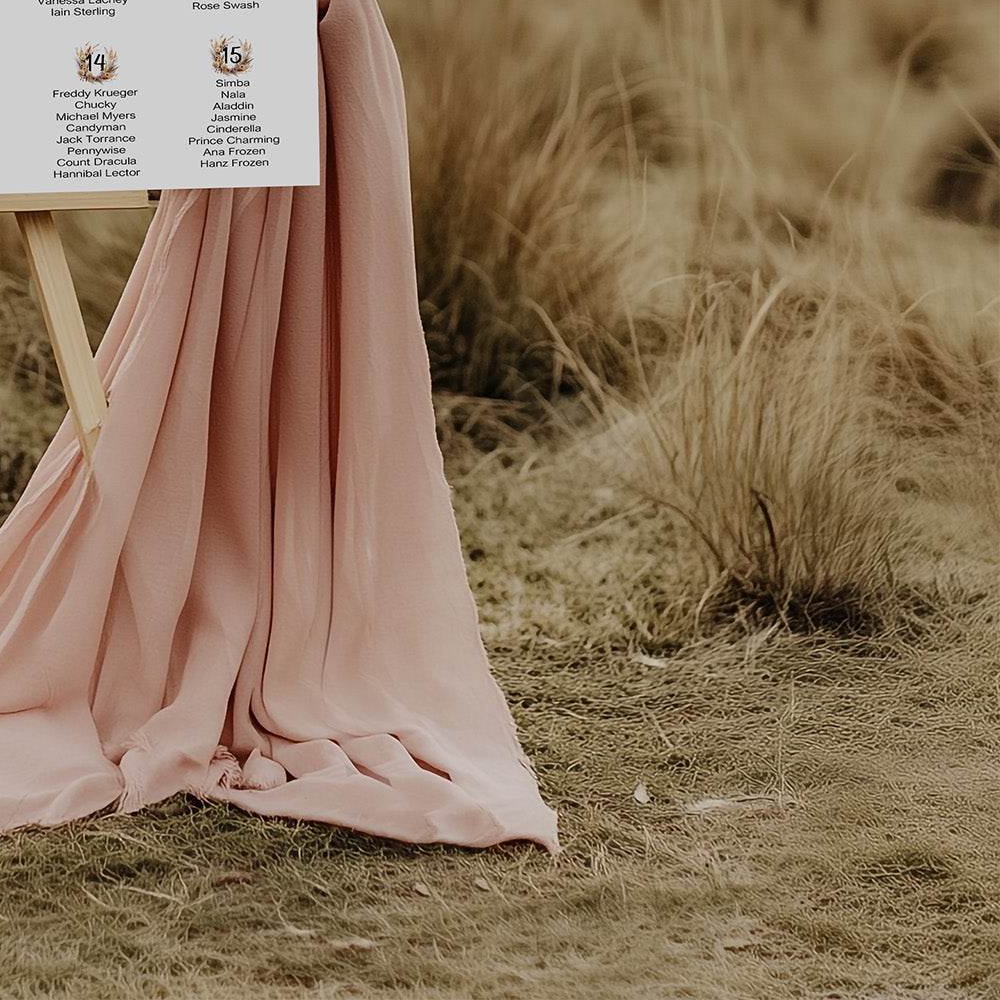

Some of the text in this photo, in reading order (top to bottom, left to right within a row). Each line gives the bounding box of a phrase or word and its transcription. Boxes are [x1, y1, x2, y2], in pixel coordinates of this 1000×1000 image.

[222, 46, 242, 64] 15
[85, 53, 106, 72] 14
[215, 78, 251, 88] Simba
[52, 88, 139, 100] Freddy Krueger
[220, 90, 246, 99] Nala
[74, 100, 117, 111] Chucky
[212, 101, 255, 111] Aladdin
[55, 111, 137, 122] Michael Myers
[210, 112, 257, 123] Jasmine
[65, 123, 127, 134] Candyman
